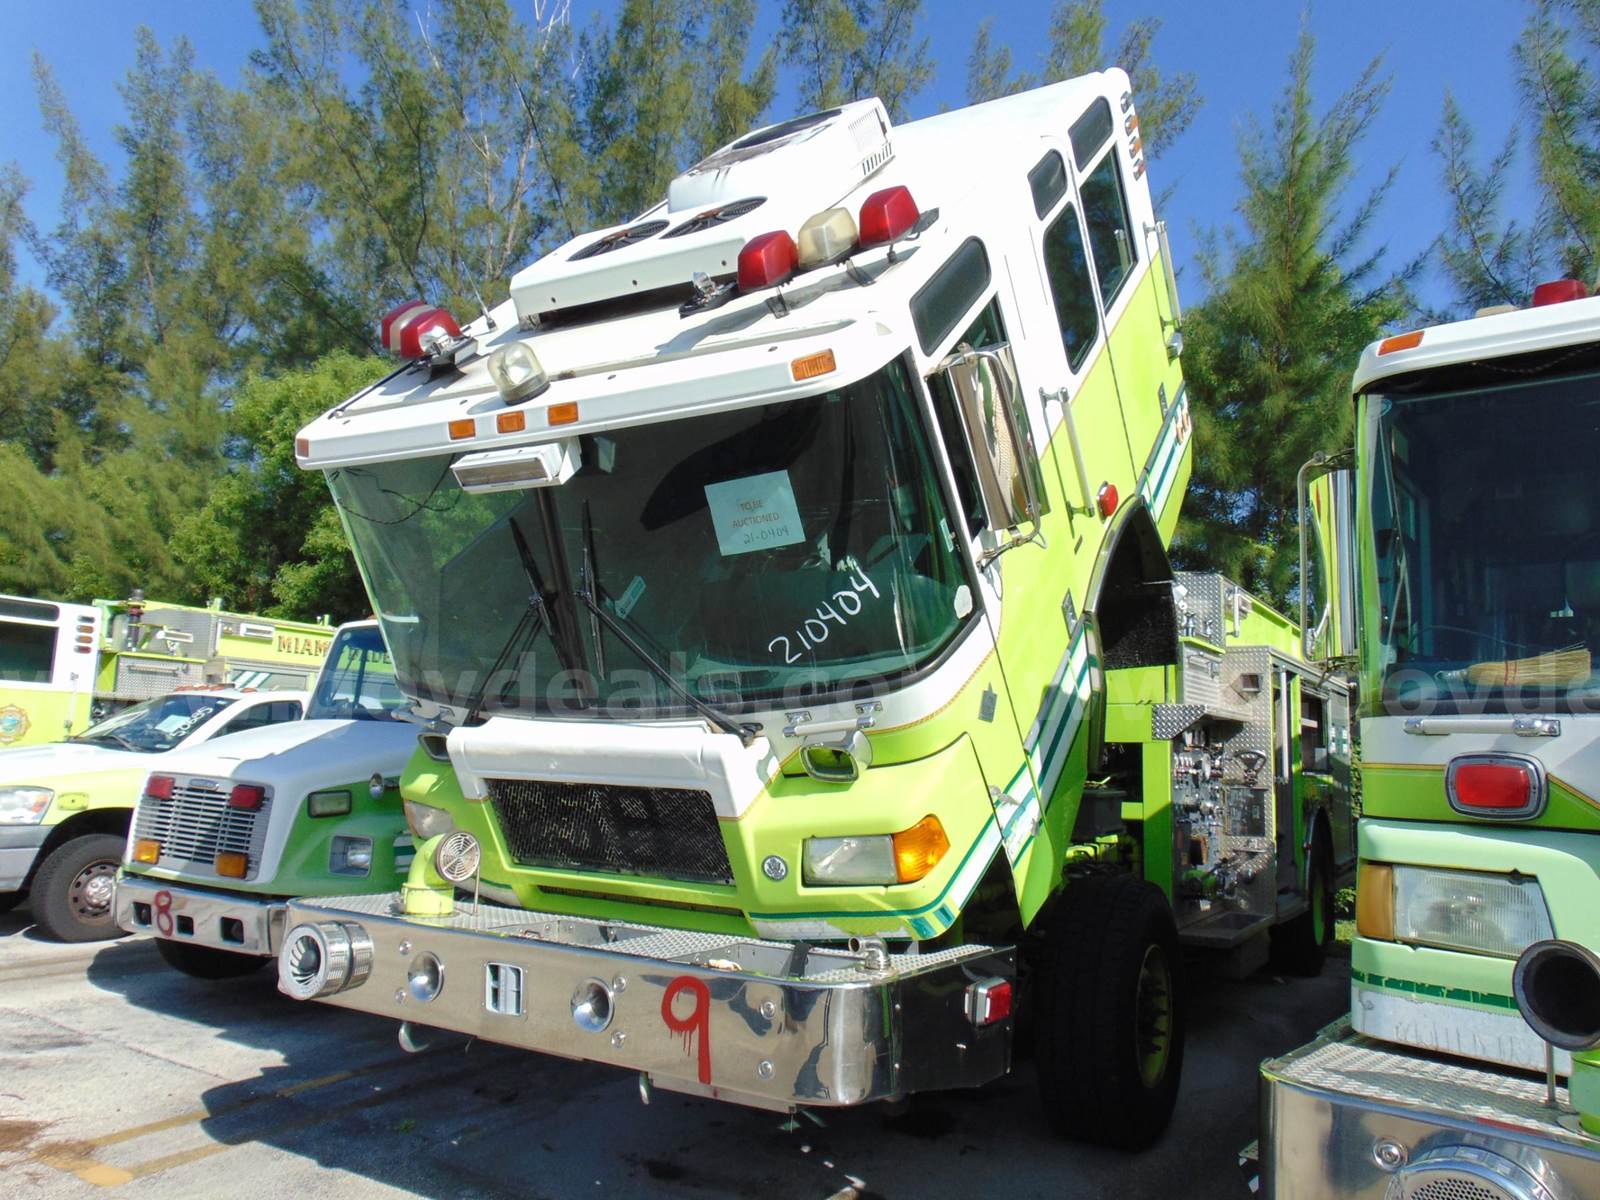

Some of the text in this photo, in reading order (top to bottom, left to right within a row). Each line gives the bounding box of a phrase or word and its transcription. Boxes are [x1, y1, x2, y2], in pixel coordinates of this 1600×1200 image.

[744, 525, 789, 544] 21-0404
[768, 559, 881, 664] 210404
[277, 635, 329, 657] MIAM
[661, 974, 712, 1086] 9
